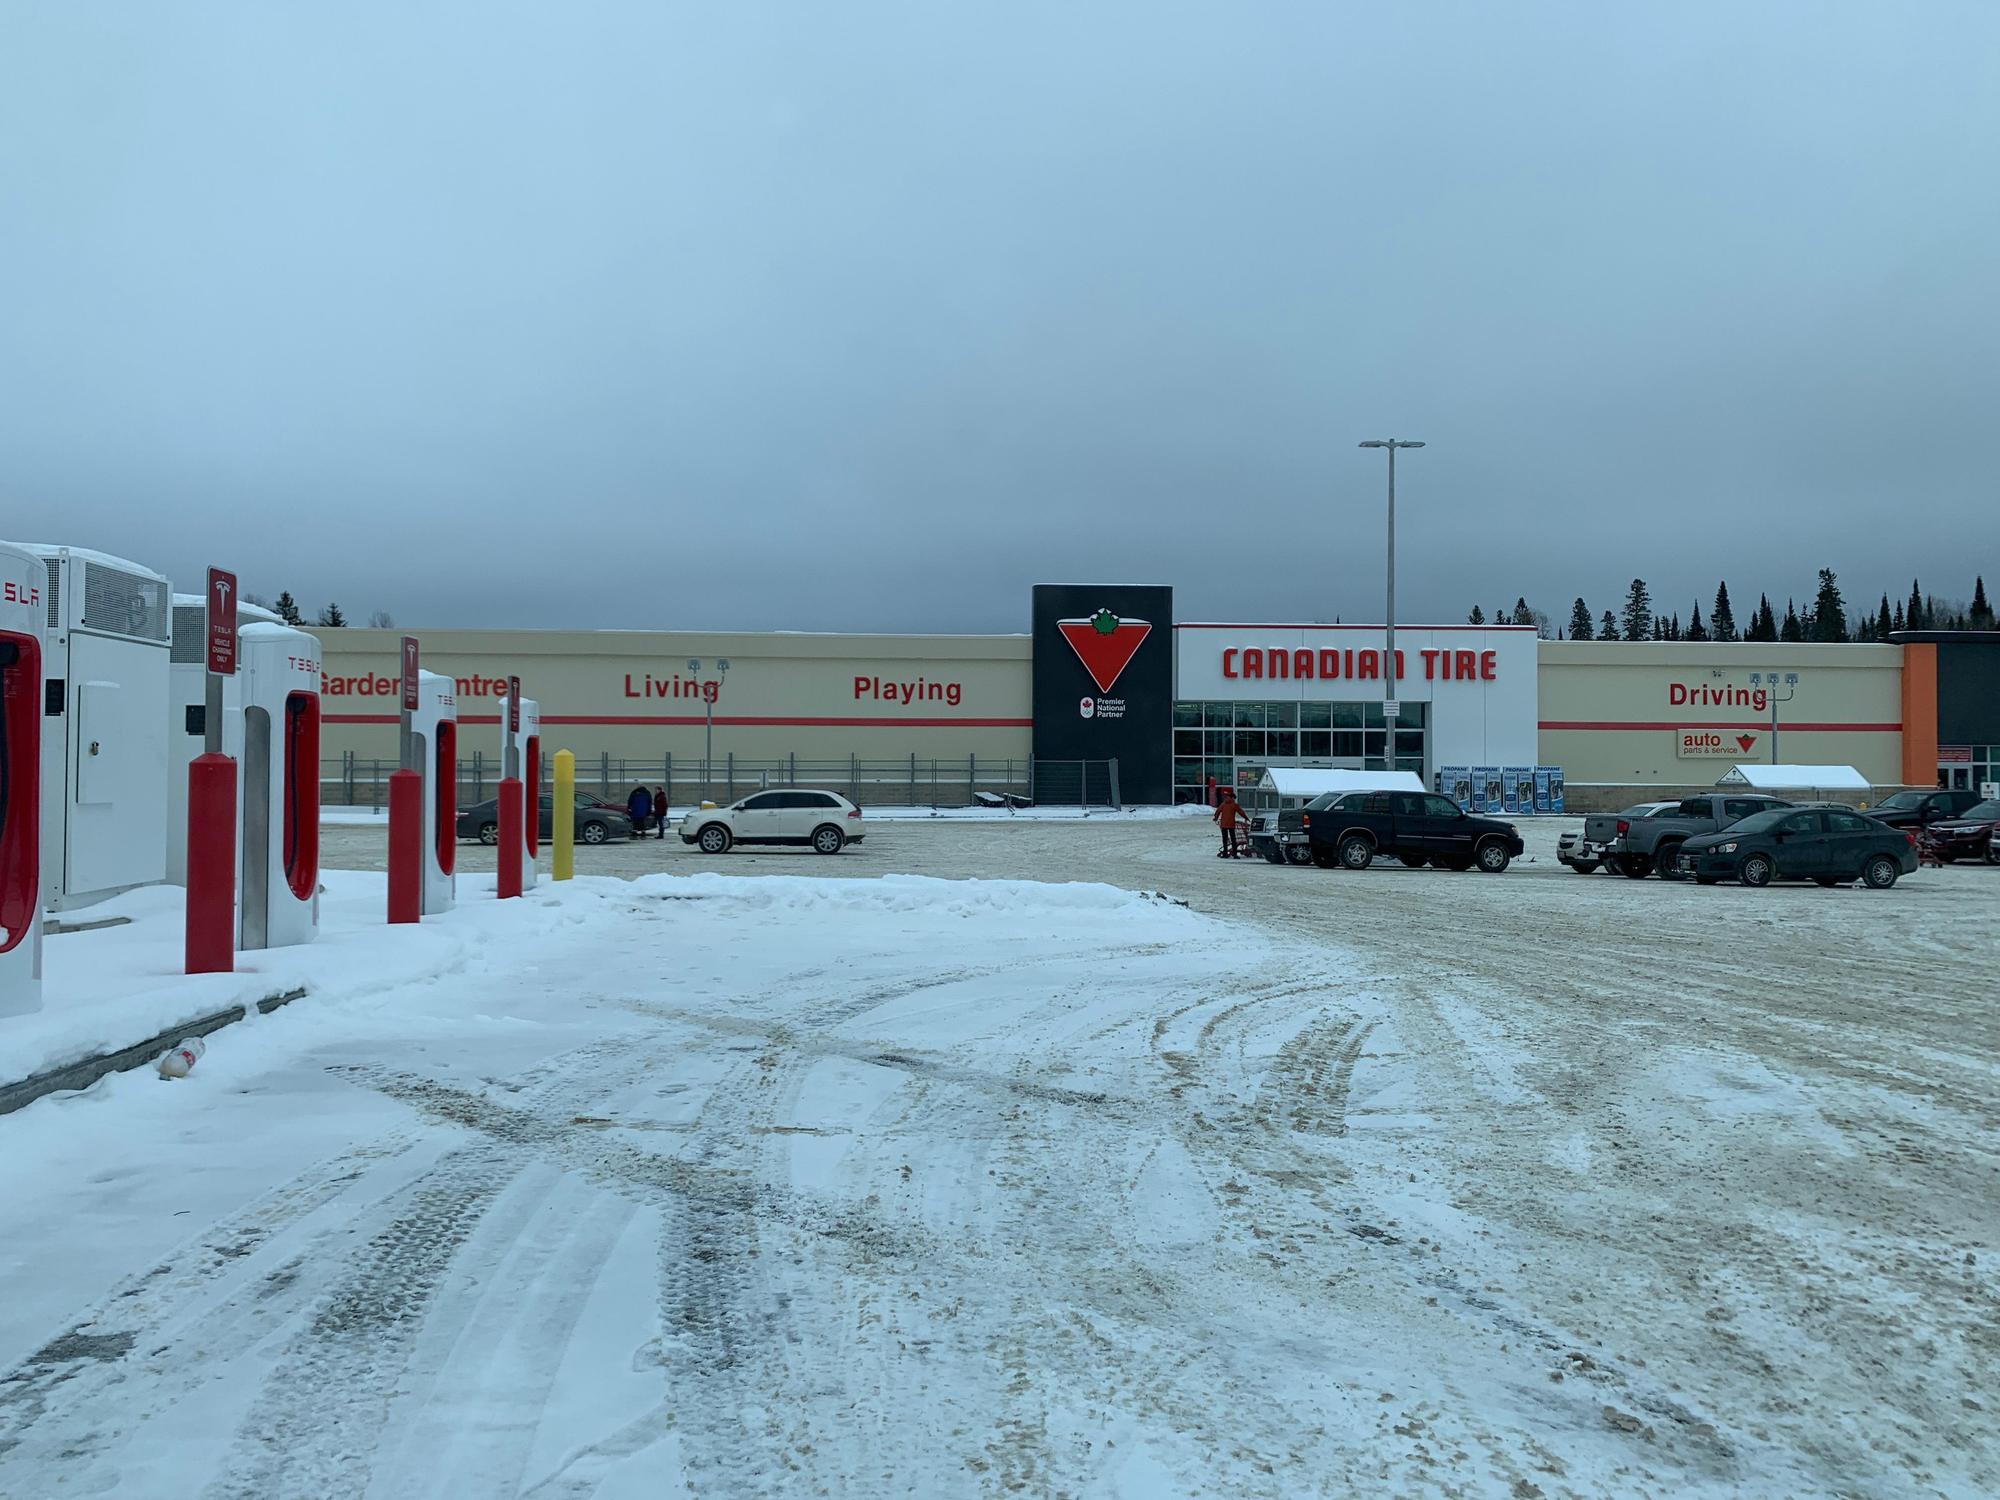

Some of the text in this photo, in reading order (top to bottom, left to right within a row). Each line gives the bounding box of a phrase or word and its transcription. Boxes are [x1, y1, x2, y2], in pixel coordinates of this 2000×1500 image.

[4, 582, 39, 607] SLA
[216, 655, 228, 663] ONLY
[1223, 647, 1497, 681] CANADIAN TIRE
[625, 674, 719, 704] Living
[854, 676, 961, 706] Playing
[1669, 683, 1767, 712] Driving
[1097, 697, 1126, 705] Premier
[1097, 710, 1124, 718] Partner
[1683, 733, 1721, 747] auto
[1683, 747, 1703, 755] parts
